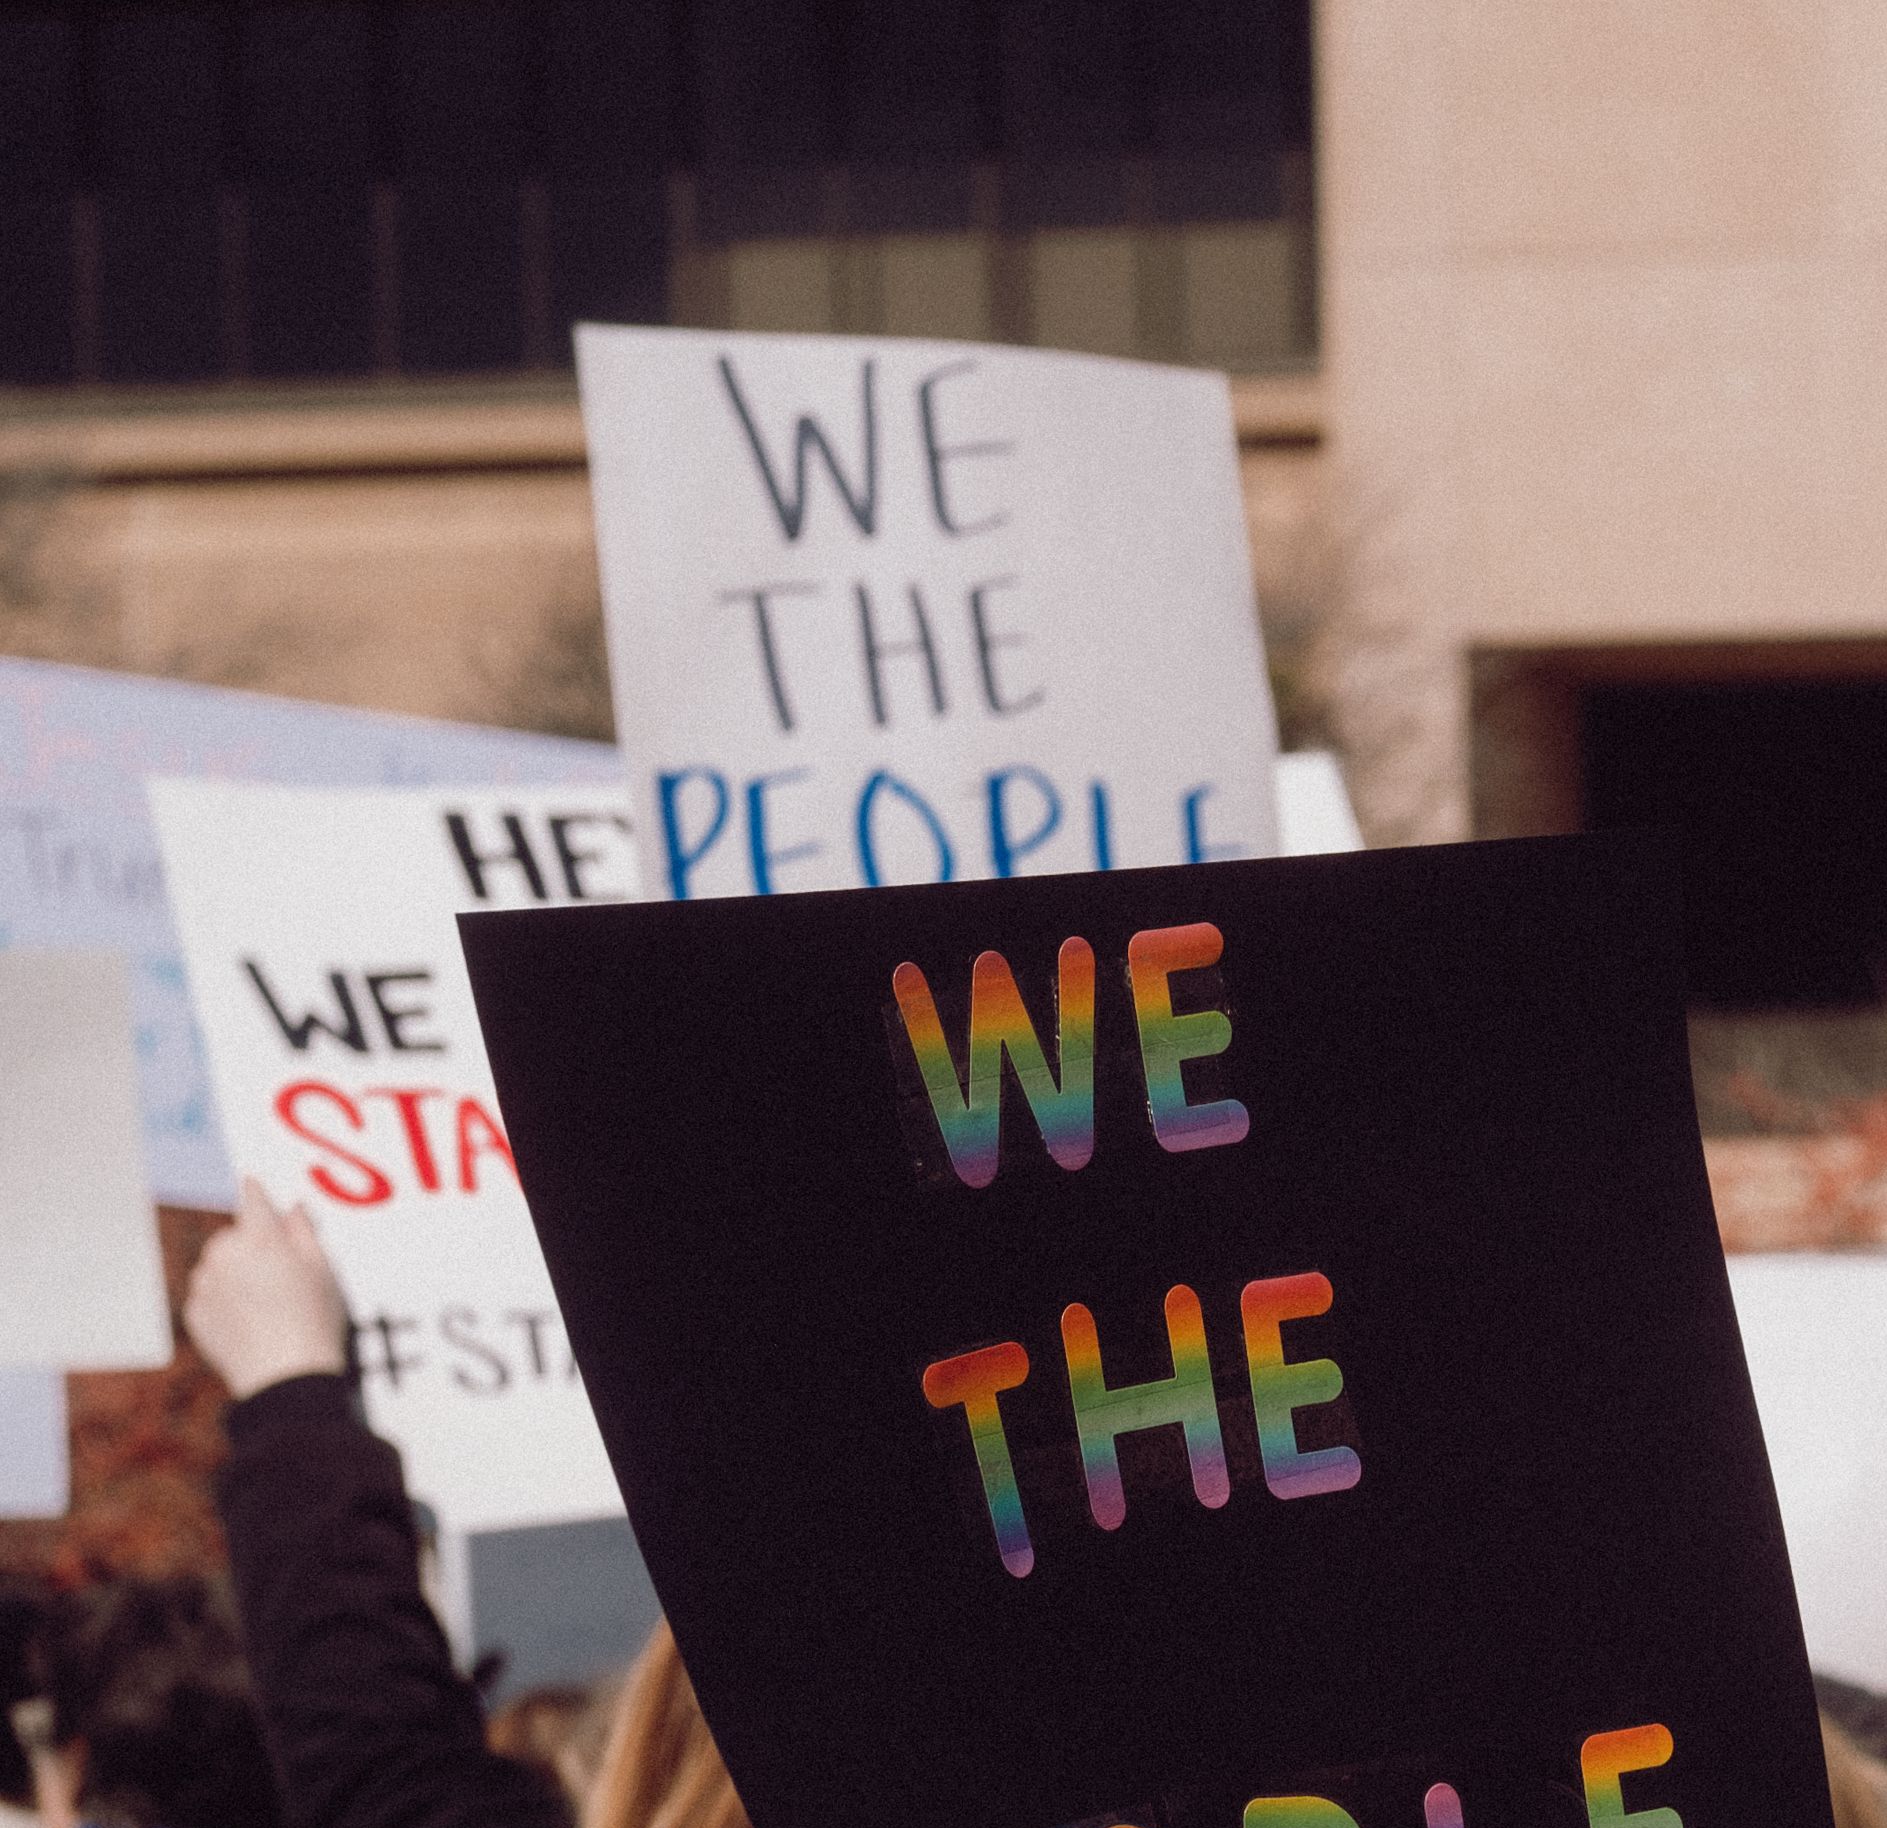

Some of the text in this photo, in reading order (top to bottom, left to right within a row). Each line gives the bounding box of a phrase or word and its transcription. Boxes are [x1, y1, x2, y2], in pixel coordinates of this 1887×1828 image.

[718, 355, 1017, 543] WE
[712, 574, 1046, 732] THE
[445, 808, 633, 901] HE
[240, 956, 447, 1056] WE
[892, 922, 1250, 1188] WE
[350, 1310, 580, 1394] #ST
[923, 1272, 1362, 1578] THE
